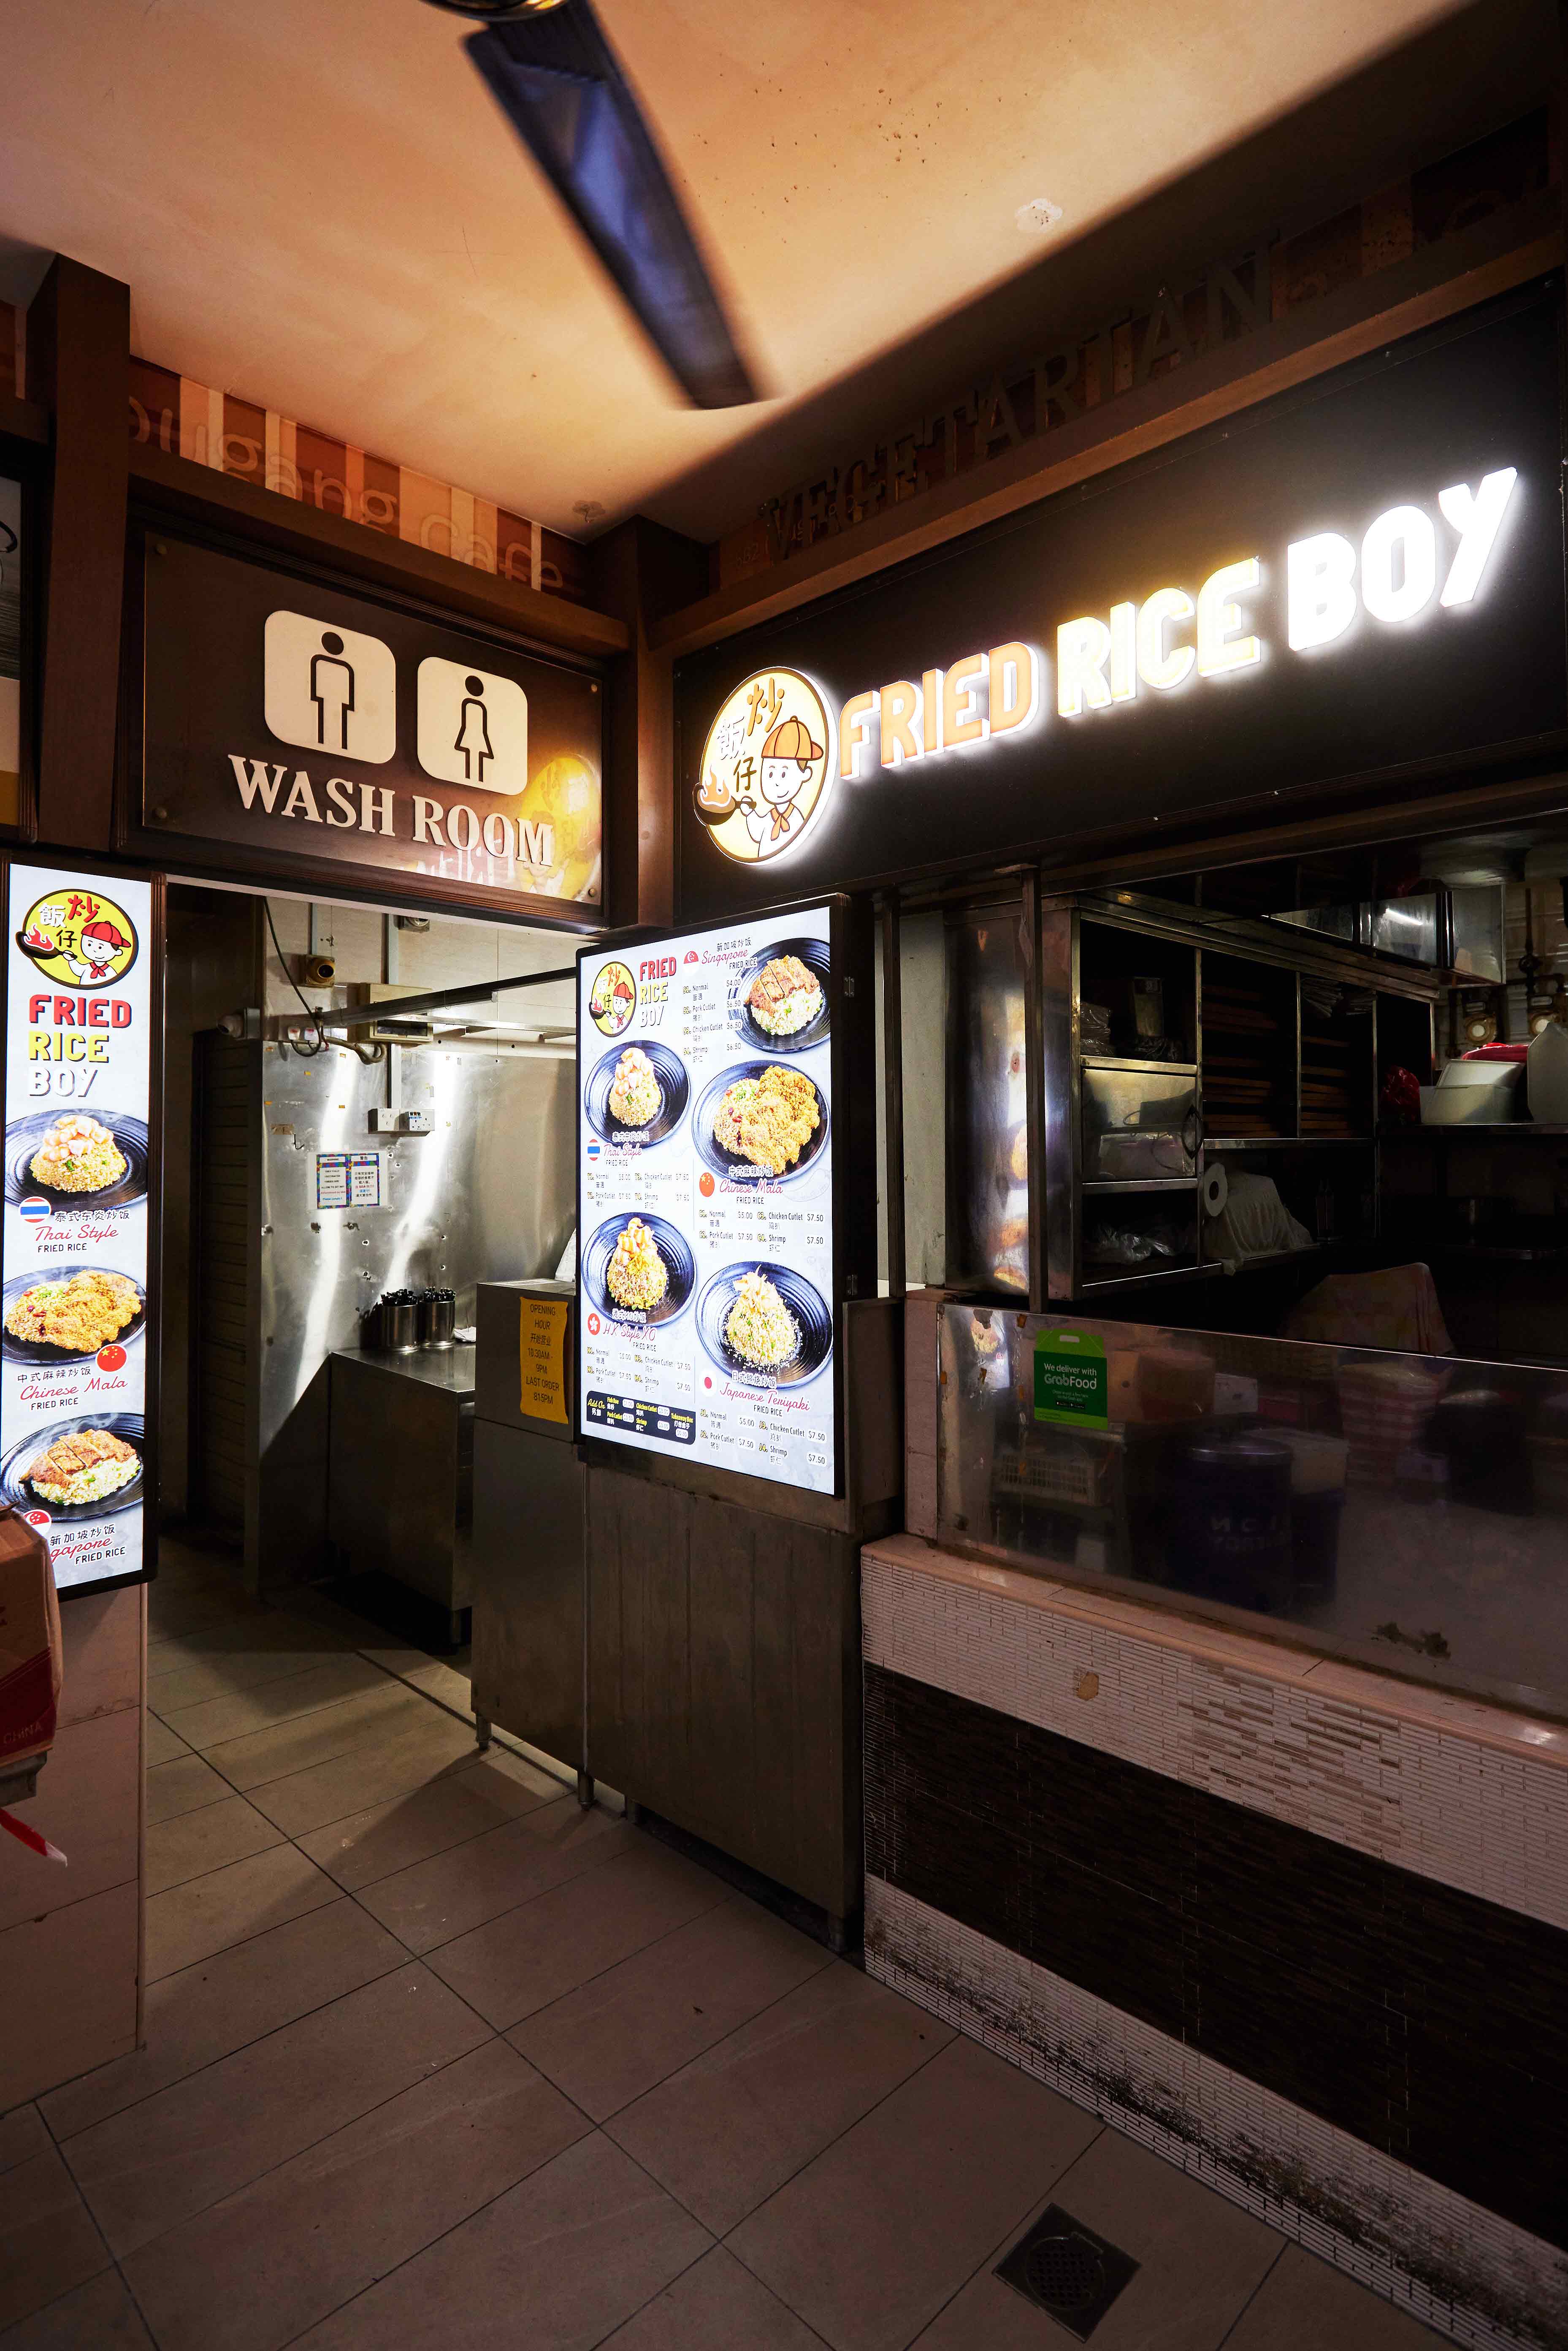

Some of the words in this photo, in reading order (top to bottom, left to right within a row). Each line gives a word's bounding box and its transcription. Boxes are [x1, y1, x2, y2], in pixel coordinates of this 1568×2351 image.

[840, 642, 1039, 780] FRIED
[1057, 557, 1261, 718] RICE
[1287, 466, 1517, 652] BOY
[228, 755, 395, 836] WASH
[413, 795, 554, 866] ROOM
[702, 950, 748, 966] Singapore
[730, 961, 743, 969] FRIED
[746, 959, 756, 967] RICE
[640, 957, 676, 981] FRIED
[640, 982, 668, 1004] RICE
[693, 983, 708, 991] Normal
[29, 994, 131, 1028] FRIED
[640, 1006, 664, 1027] BOY
[29, 1031, 109, 1063] RICE
[29, 1066, 98, 1097] BOY
[604, 1144, 620, 1156] Thai
[623, 1143, 642, 1160] Style
[720, 1179, 753, 1193] Chinese
[756, 1179, 783, 1193] Mala
[55, 1211, 129, 1222] 泰式东炎炒饭
[35, 1226, 72, 1241] Thai
[77, 1224, 119, 1243] Style
[769, 1234, 785, 1244] Shrimp
[38, 1245, 64, 1253] FRIED
[530, 1304, 555, 1315] OPENING
[535, 1321, 550, 1329] HOUR
[621, 1324, 640, 1342] Style
[642, 1327, 656, 1341] XO
[645, 1356, 660, 1364] Chicken
[18, 1366, 91, 1383] 中式麻辣炒饭
[536, 1364, 547, 1375] 9PM
[1044, 1363, 1055, 1371] We
[1057, 1364, 1080, 1374] deliver
[20, 1386, 79, 1400] Chinese
[84, 1376, 128, 1392] Mala
[526, 1377, 540, 1386] LAST
[542, 1380, 559, 1391] ORDER
[645, 1377, 658, 1386] Shrimp
[1044, 1374, 1097, 1389] GrabFood
[31, 1401, 56, 1410] FRIED
[60, 1398, 79, 1406] RICE
[588, 1399, 598, 1407] Add
[598, 1401, 605, 1409] On
[720, 1383, 764, 1402] Japanese
[767, 1391, 810, 1412] Teriyaki
[754, 1405, 768, 1414] FRIED
[771, 1408, 782, 1416] RICE
[710, 1412, 726, 1420] Normal
[739, 1418, 754, 1426] $5.00
[710, 1433, 720, 1442] Pork
[721, 1434, 734, 1443] Cutlet
[739, 1439, 753, 1448] $7.50
[770, 1424, 789, 1434] Chicken
[790, 1426, 804, 1436] Cutlet
[809, 1431, 825, 1441] $7.50
[770, 1446, 787, 1457] Shrimp
[808, 1453, 825, 1464] $7.50
[50, 1524, 115, 1546] 新加坡炒饭
[51, 1538, 112, 1563] gapore
[76, 1553, 102, 1564] FRIED
[106, 1547, 125, 1558] RICE
